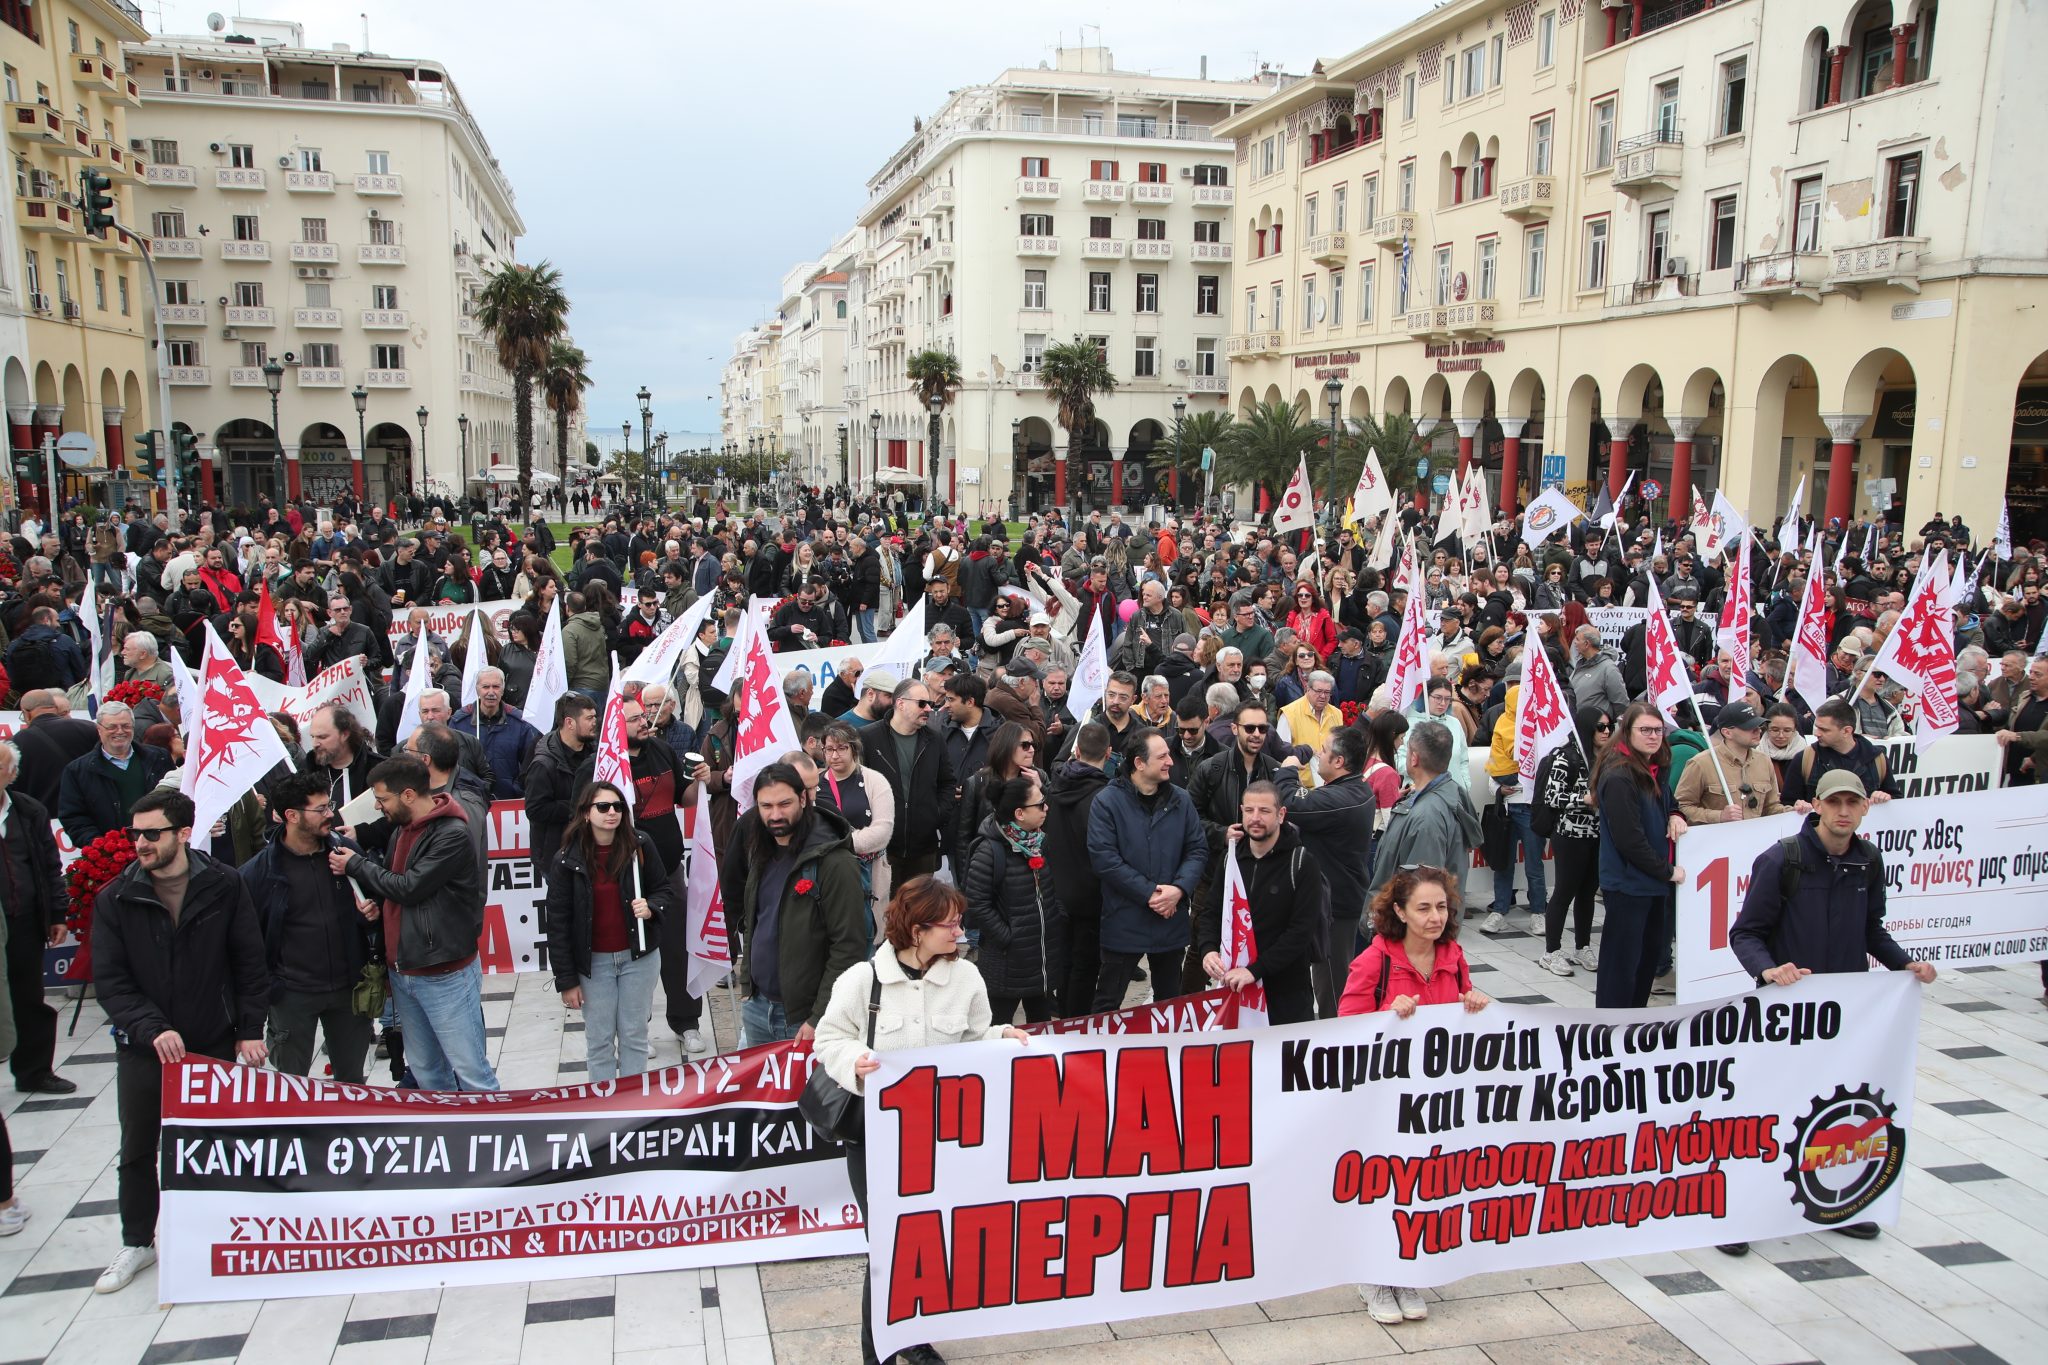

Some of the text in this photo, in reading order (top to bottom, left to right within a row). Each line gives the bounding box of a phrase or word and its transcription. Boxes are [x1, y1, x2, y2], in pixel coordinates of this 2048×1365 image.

[303, 451, 335, 462] XOXO
[1876, 818, 1963, 857] τους χθες
[1910, 854, 1974, 892] αγώνες
[1978, 855, 2007, 887] μας
[1927, 916, 1971, 929] СЕГОДНЯ
[1945, 942, 1991, 959] TELEKOM
[1994, 938, 2026, 956] CLOUD
[1150, 998, 1224, 1035] ΜΑΣ
[640, 1055, 742, 1097] ΤΟΥΣ
[1281, 1032, 1412, 1093] Καμία
[1555, 1023, 1618, 1077] για
[1623, 1018, 1687, 1055] τον
[879, 1040, 1254, 1198] 1η ΜΑΗ
[1397, 1057, 1736, 1135] και τα Κέρδη τους
[175, 1120, 813, 1177] ΚΑΜΙΑ ΘΥΣΙΑ ΓΙΑ ΤΑ ΚΕΡΔΗ ΚΑΙ
[1332, 1110, 1780, 1206] Οργάνωση και Αγώνας
[229, 1186, 787, 1242] ΣΥΝΔΙΚΑΤΟ ΕΡΓΑΤΟΫΠΑΛΛΗΛΩΝ
[1392, 1161, 1727, 1261] για την Ανατροπή
[221, 1234, 512, 1274] ΤΗΛΕΠΙΚΟΙΝΩΝΙΩΝ
[524, 1232, 546, 1255] &
[558, 1211, 788, 1254] ΠΛΗΡΟΦΟΡΙΚΗΣ
[887, 1182, 1255, 1326] ΑΠΕΡΓΙΑ
